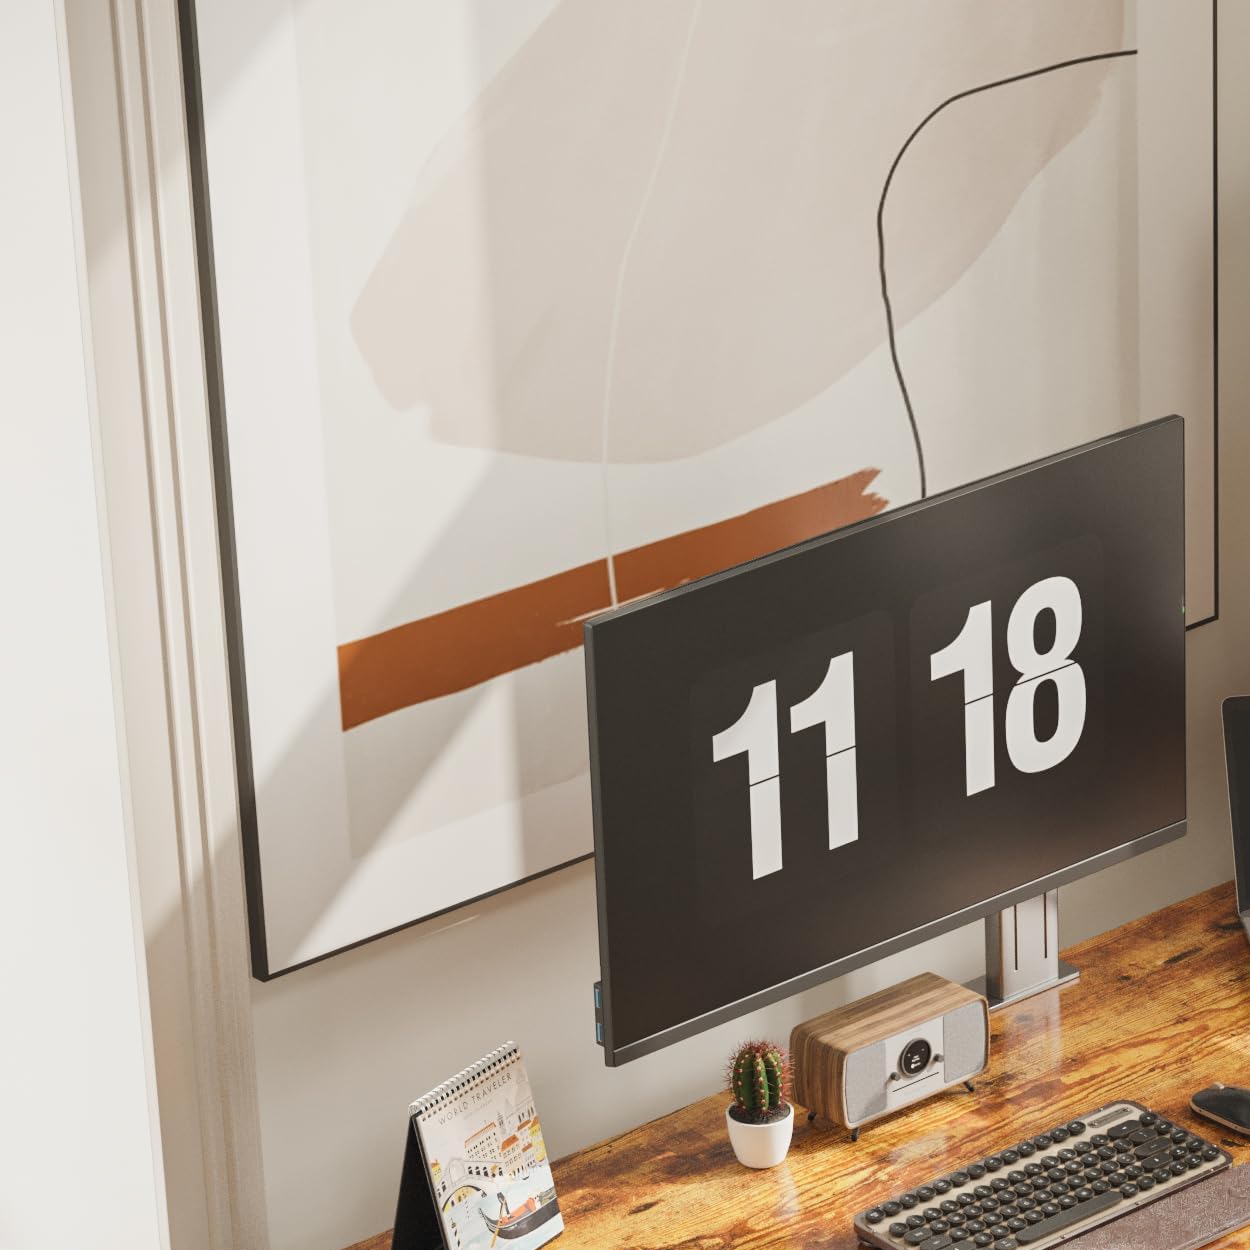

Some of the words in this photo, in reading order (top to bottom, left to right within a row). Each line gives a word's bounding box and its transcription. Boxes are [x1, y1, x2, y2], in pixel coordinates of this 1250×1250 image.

[712, 651, 859, 880] 11
[930, 576, 1087, 797] 18
[439, 1101, 469, 1125] WORLD
[471, 1072, 512, 1104] TRAVELER
